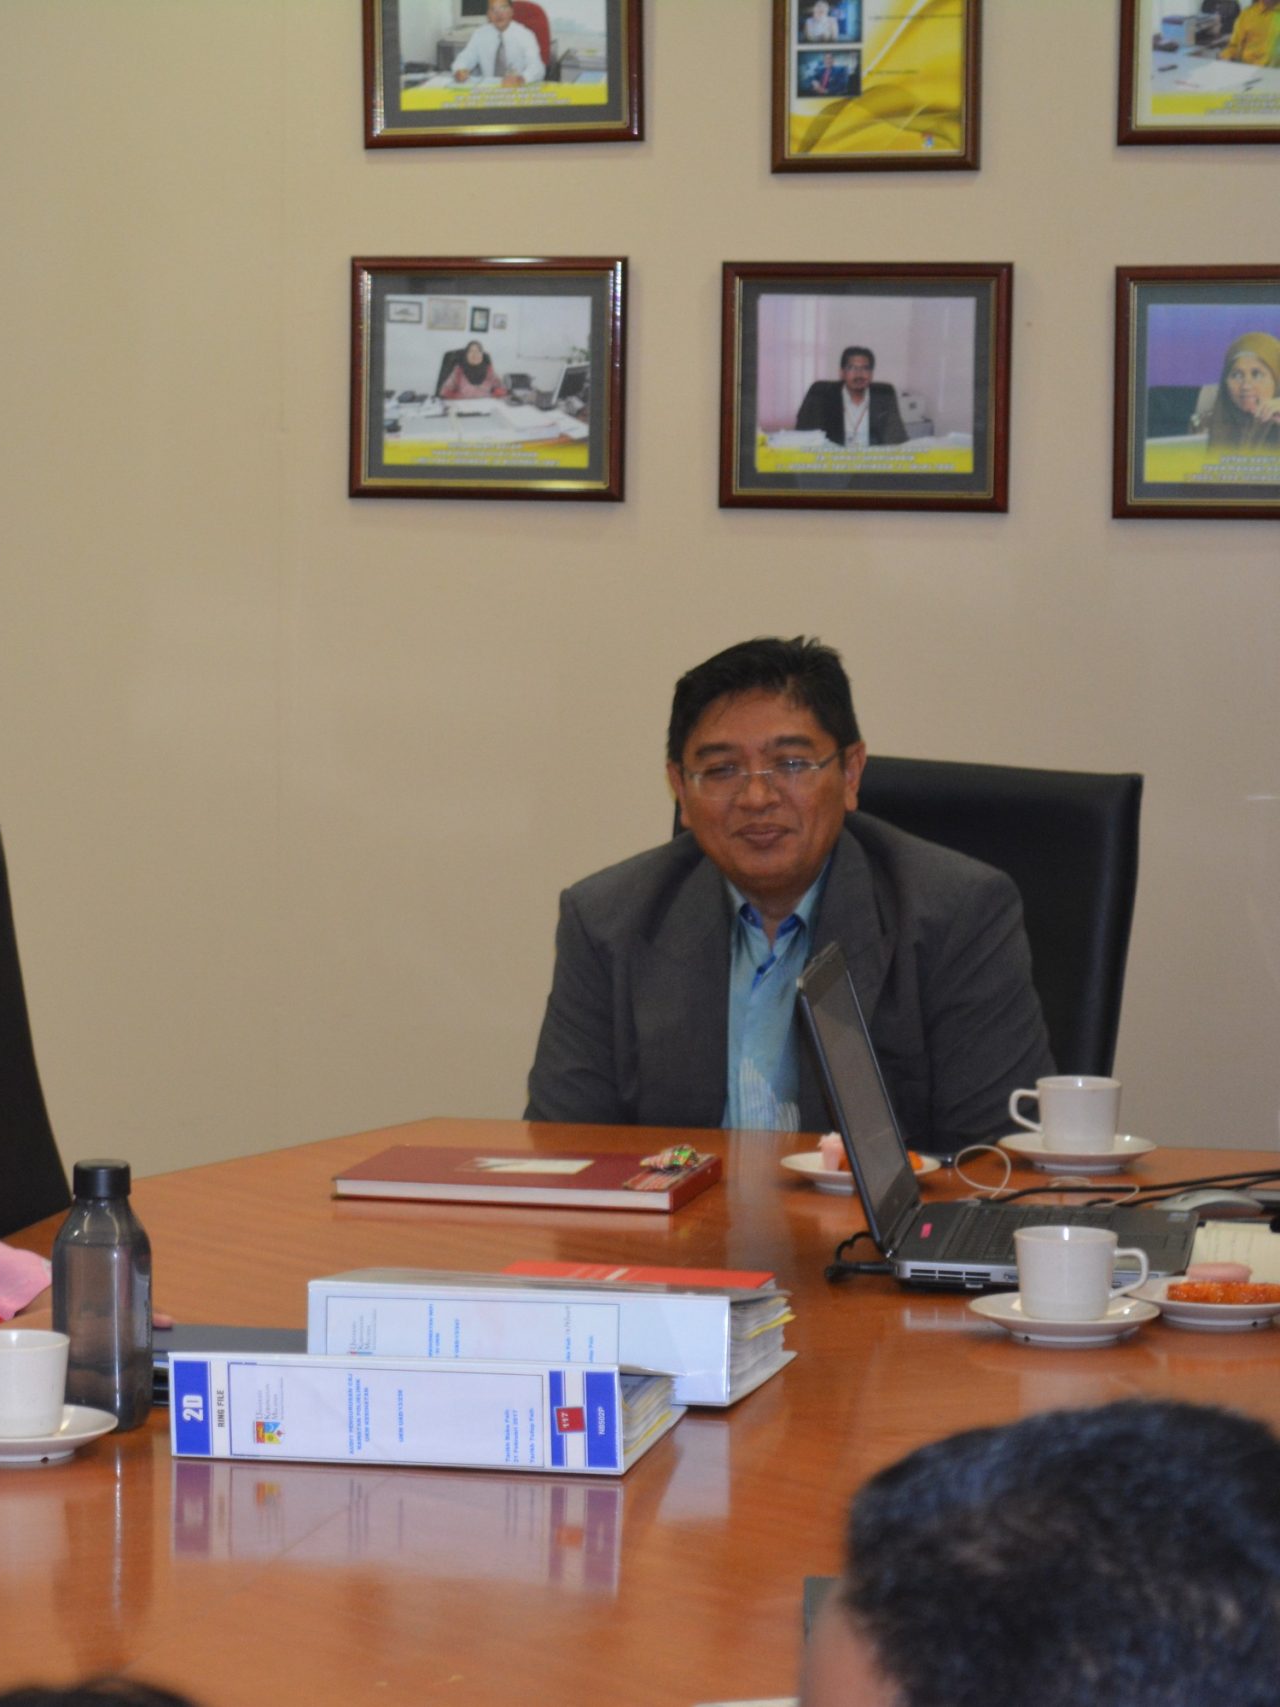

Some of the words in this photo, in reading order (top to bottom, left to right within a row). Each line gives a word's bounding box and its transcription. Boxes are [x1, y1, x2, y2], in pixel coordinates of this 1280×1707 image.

[216, 1389, 225, 1407] FILE
[182, 1395, 204, 1422] 2D
[217, 1409, 225, 1428] RING
